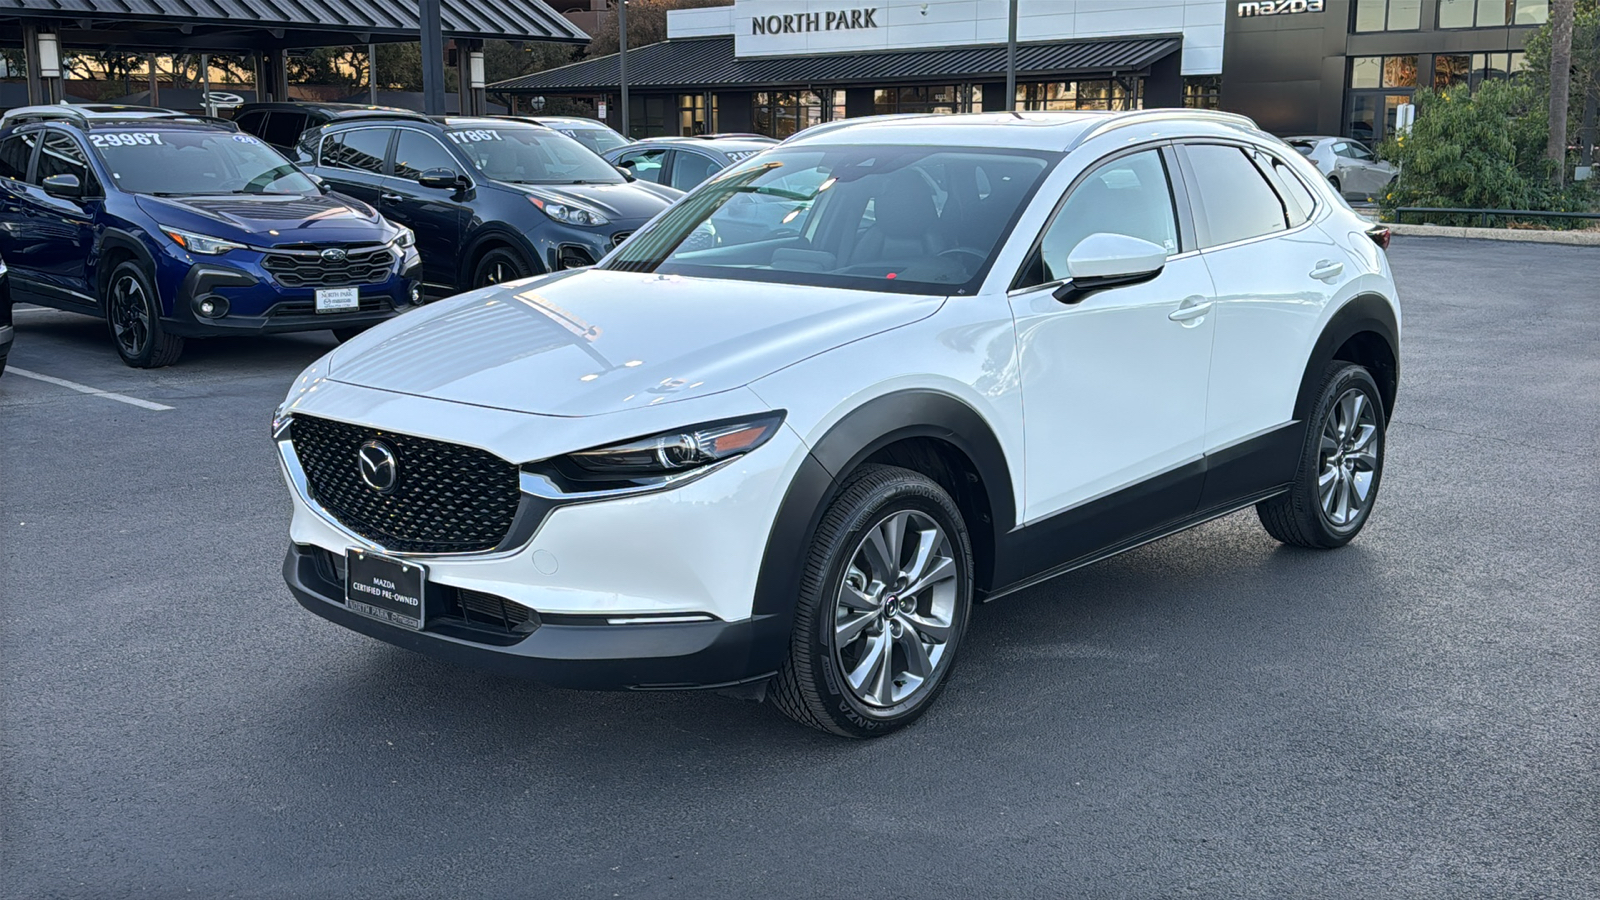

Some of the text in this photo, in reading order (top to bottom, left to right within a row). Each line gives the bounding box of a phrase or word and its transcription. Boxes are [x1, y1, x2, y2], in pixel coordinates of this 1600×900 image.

[752, 8, 878, 35] NORTH PARK
[89, 133, 163, 148] 29967
[447, 130, 503, 144] 17867
[373, 577, 396, 590] MAZDA
[352, 581, 419, 606] CERTIFIED PRE-OWNED
[349, 601, 370, 613] NORTH
[371, 607, 389, 620] PARK
